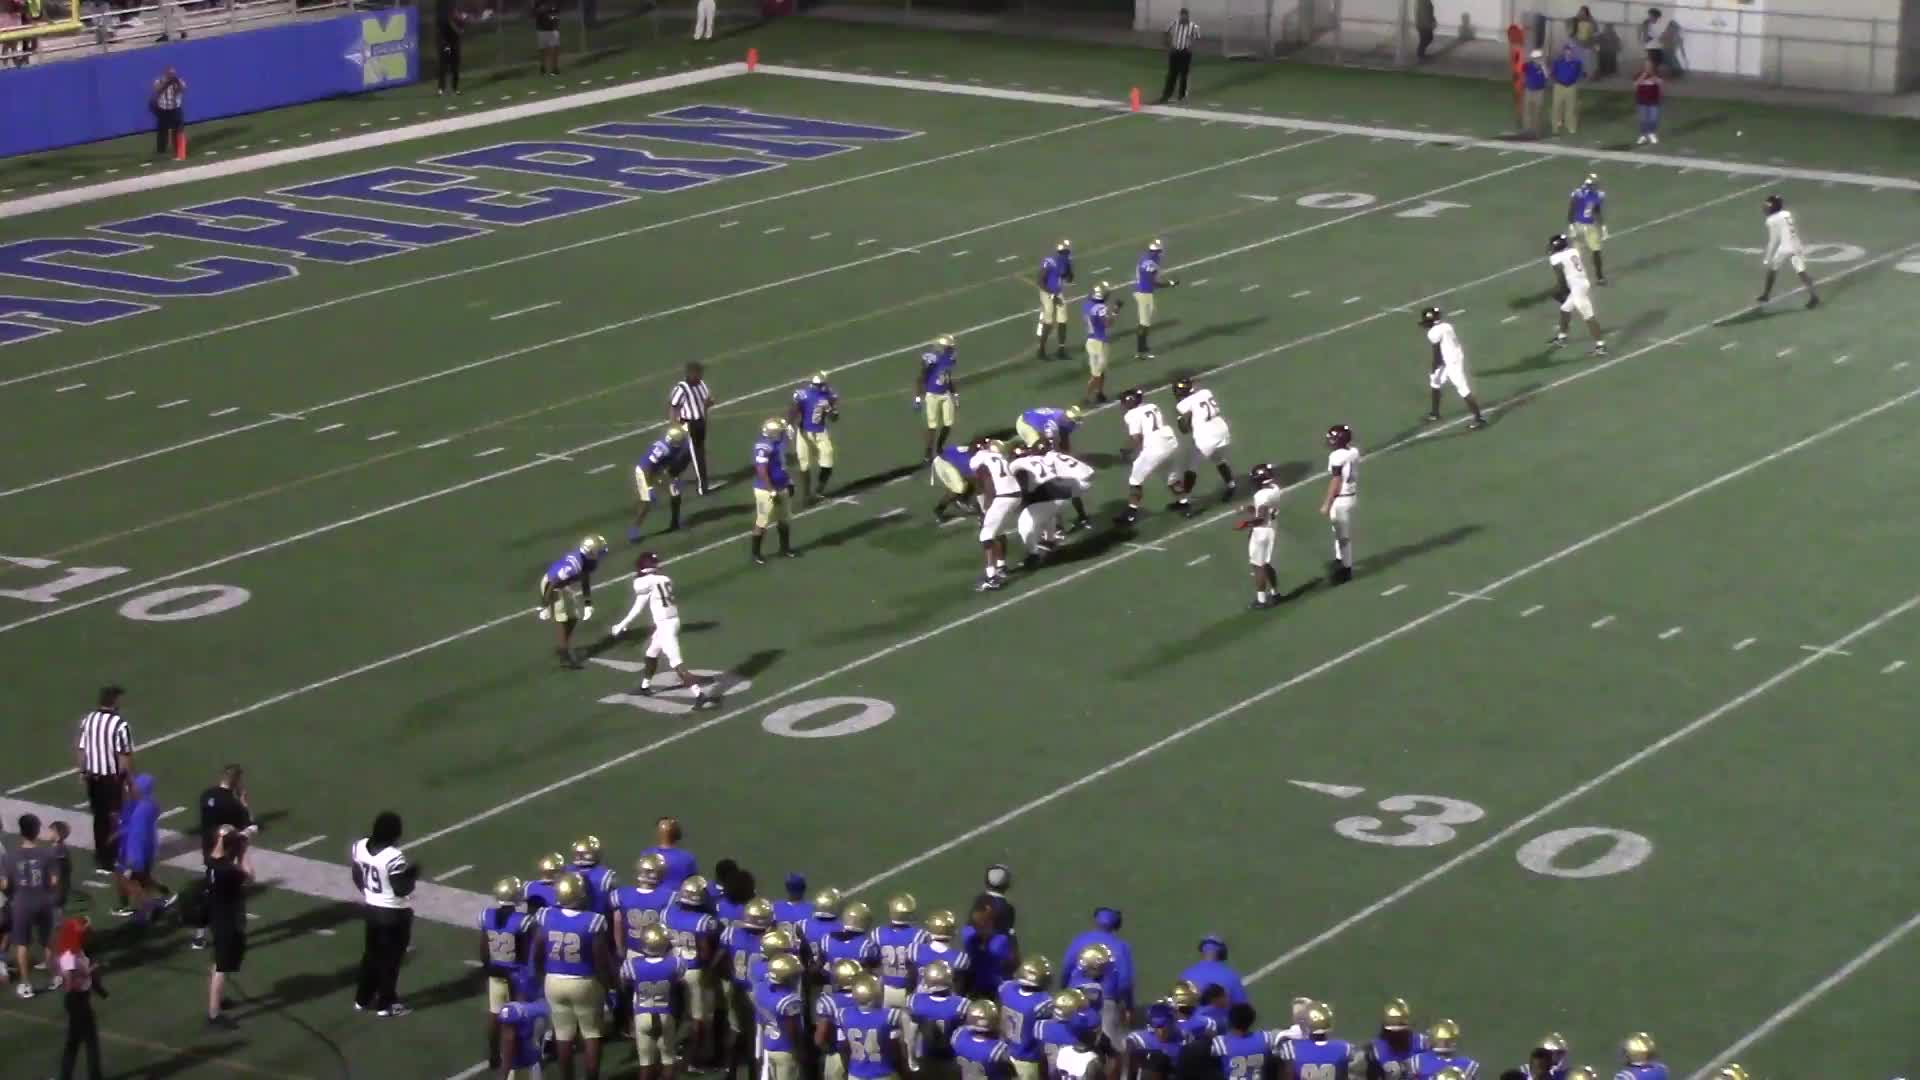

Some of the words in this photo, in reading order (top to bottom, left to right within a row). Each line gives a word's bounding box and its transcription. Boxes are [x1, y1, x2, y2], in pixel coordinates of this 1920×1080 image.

[362, 862, 383, 894] 79
[548, 930, 581, 963] 72
[848, 1028, 882, 1063] 64
